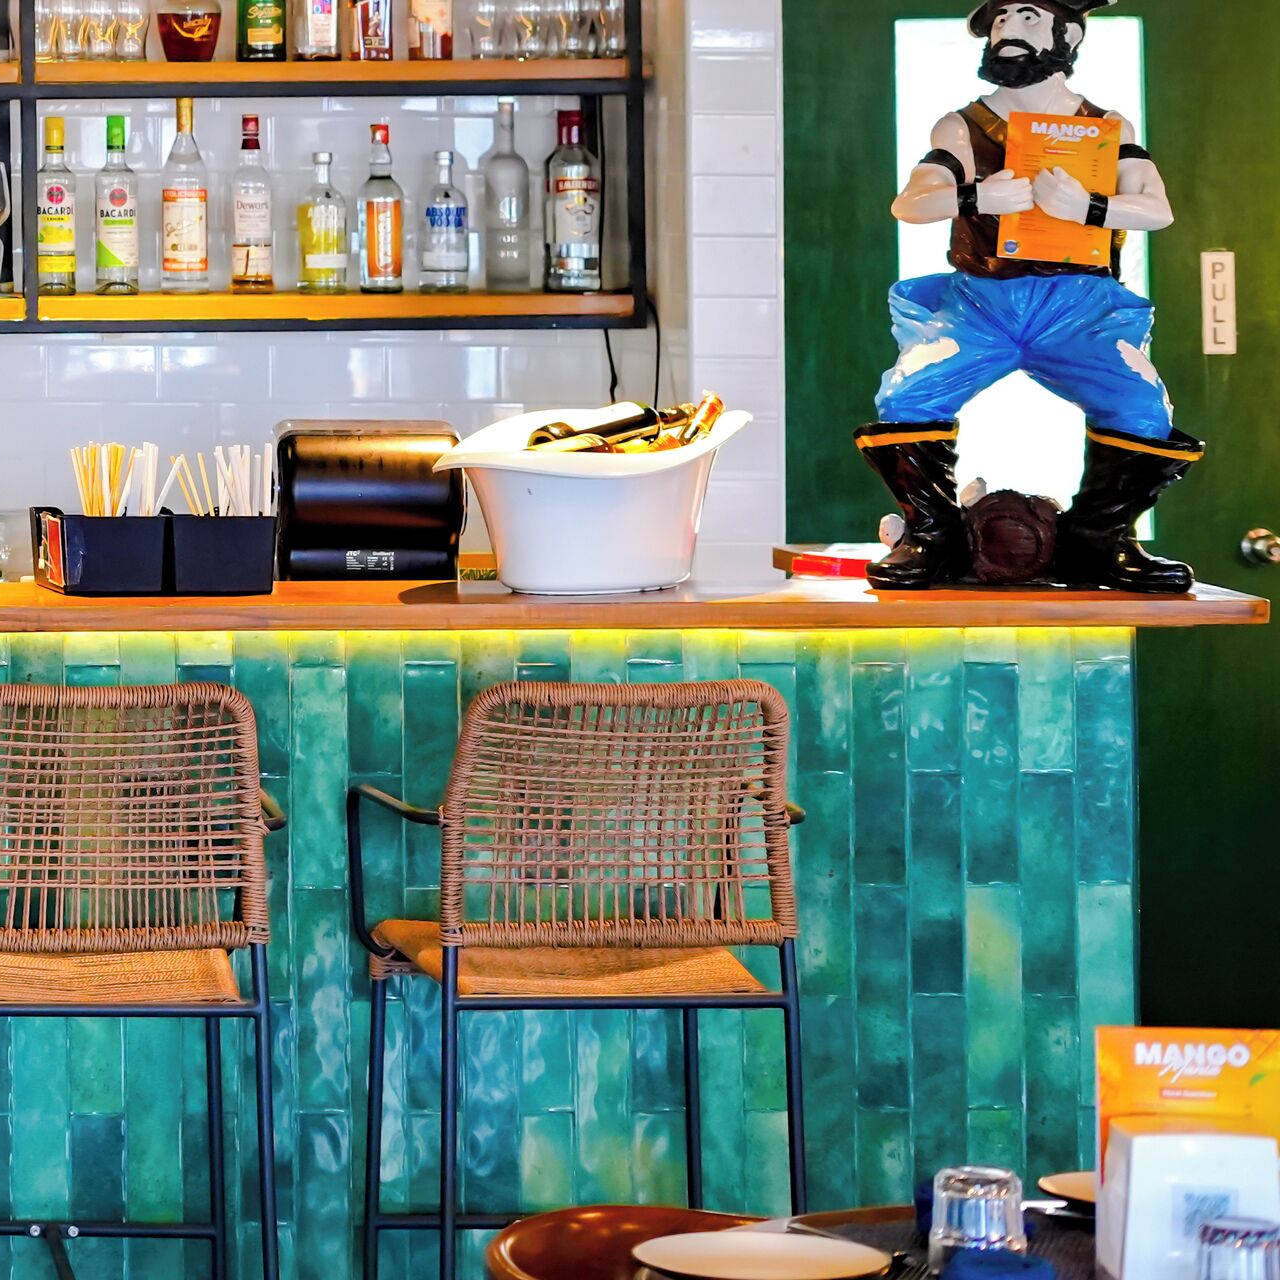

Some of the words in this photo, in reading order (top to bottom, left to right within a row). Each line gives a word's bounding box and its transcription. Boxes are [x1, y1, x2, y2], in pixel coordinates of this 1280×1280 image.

[1031, 122, 1100, 137] MANGO
[1211, 261, 1227, 345] PULL
[1135, 1042, 1251, 1069] MANGO
